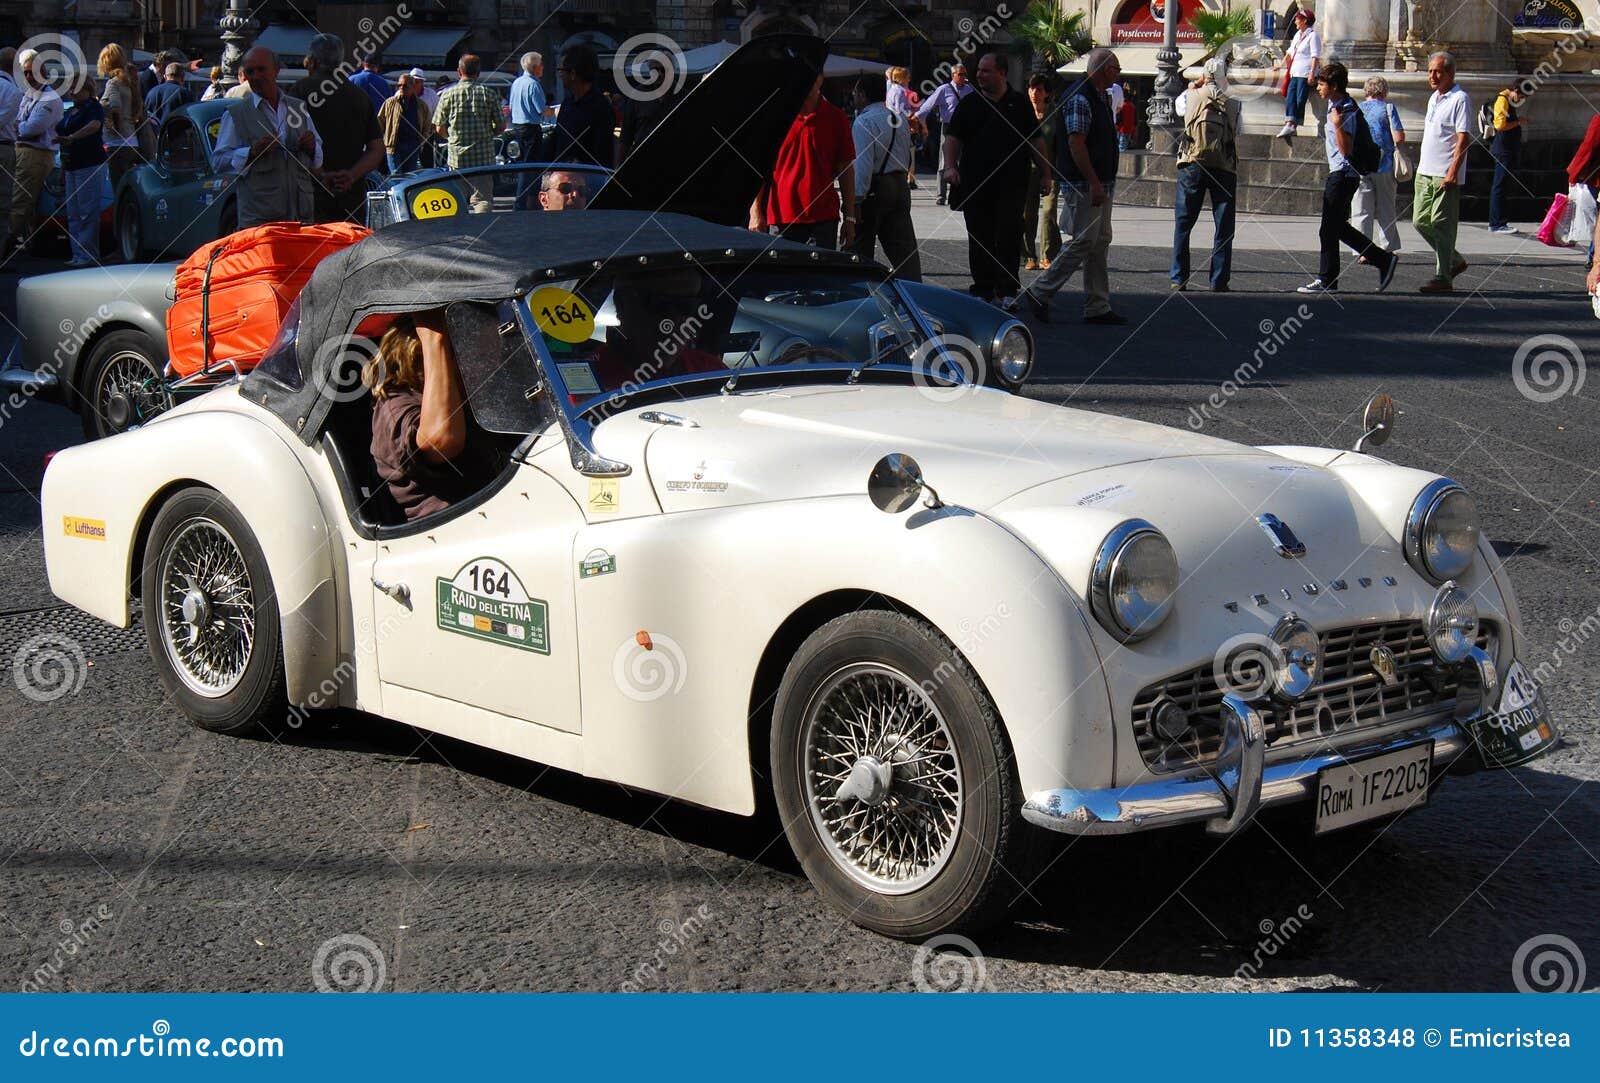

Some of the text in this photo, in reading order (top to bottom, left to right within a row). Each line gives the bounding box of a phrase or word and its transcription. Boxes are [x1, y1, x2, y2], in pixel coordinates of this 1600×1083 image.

[1117, 29, 1161, 39] Pasticceria
[420, 197, 452, 214] 180
[541, 302, 587, 327] 164
[75, 521, 106, 537] Lufthansa
[469, 565, 511, 599] 164
[451, 587, 477, 610] RAID
[478, 601, 532, 623] DELL'ETNA
[1500, 708, 1535, 736] RAID
[1362, 758, 1429, 807] 1F2203
